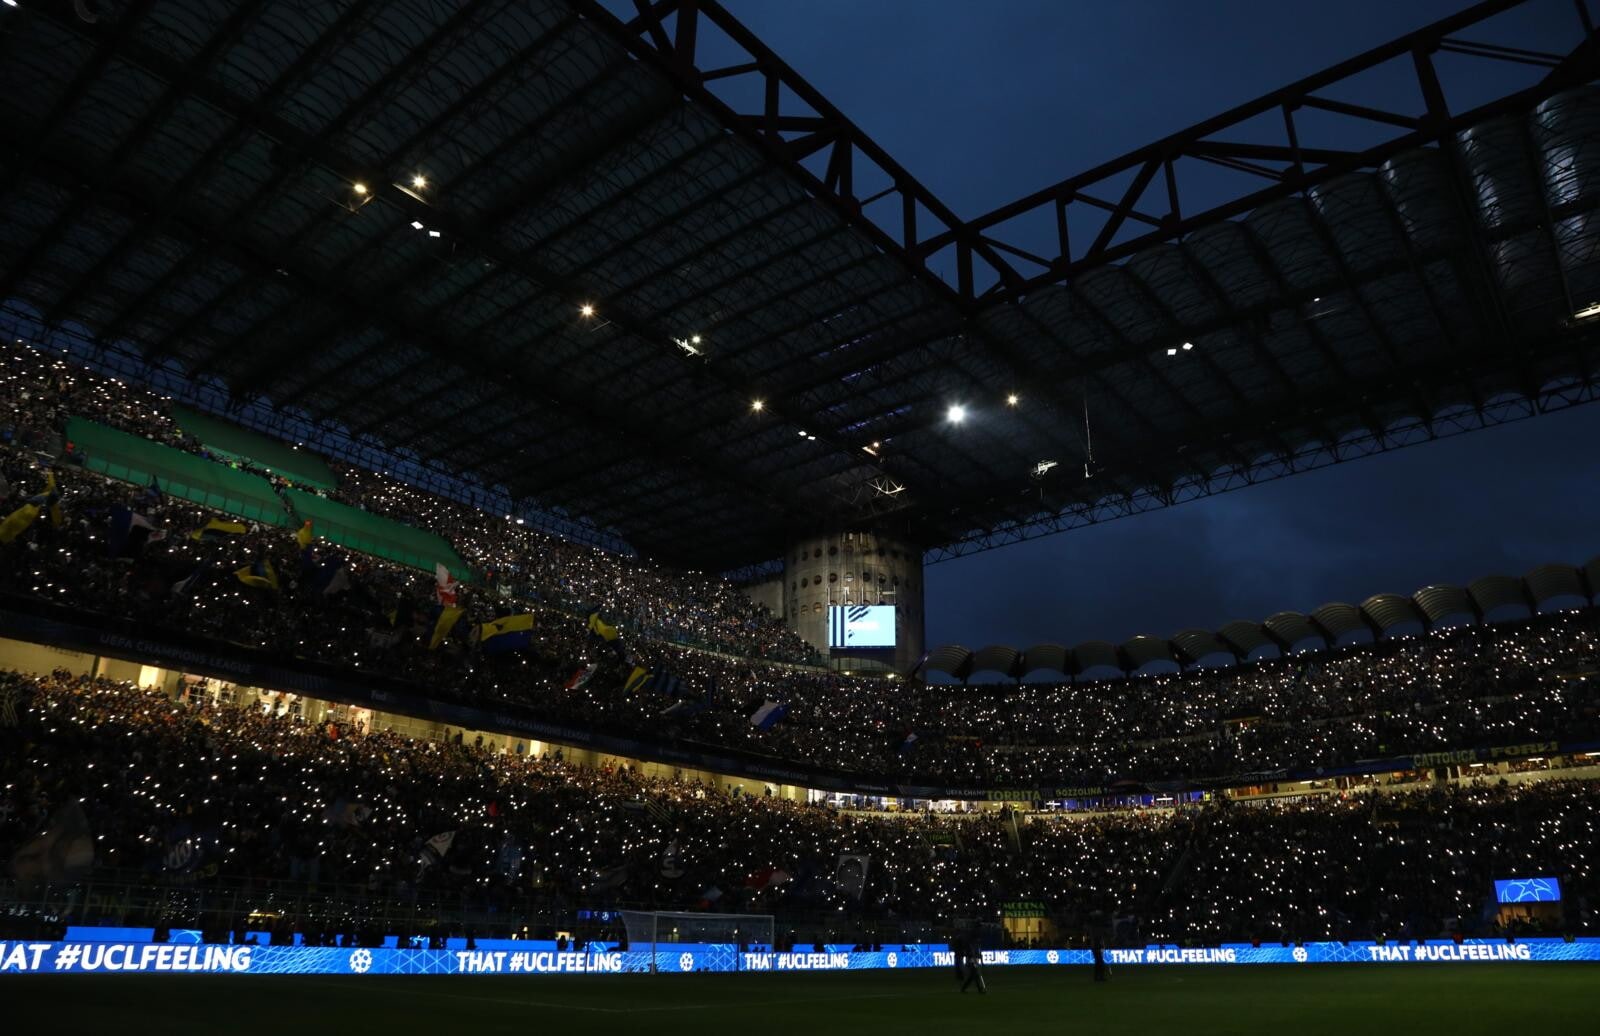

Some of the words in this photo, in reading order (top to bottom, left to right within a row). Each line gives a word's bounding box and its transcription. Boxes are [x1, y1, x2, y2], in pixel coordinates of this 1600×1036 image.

[136, 640, 207, 665] CHAMPIONS
[208, 656, 257, 674] LEAGUE
[1413, 750, 1478, 767] CATTOLICA
[985, 789, 1041, 801] TORRITA
[54, 944, 250, 971] #UCLFEELING
[932, 951, 955, 966] THAT
[1111, 949, 1144, 964] THAT
[1146, 948, 1236, 963] #UCLFEELING
[1368, 946, 1411, 961] THAT
[1414, 944, 1531, 961] #UCLFEELING
[456, 951, 507, 972] THAT
[509, 952, 622, 972] #UCLFEELING
[745, 953, 776, 970] THAT
[778, 953, 848, 969] #UCLFEELING
